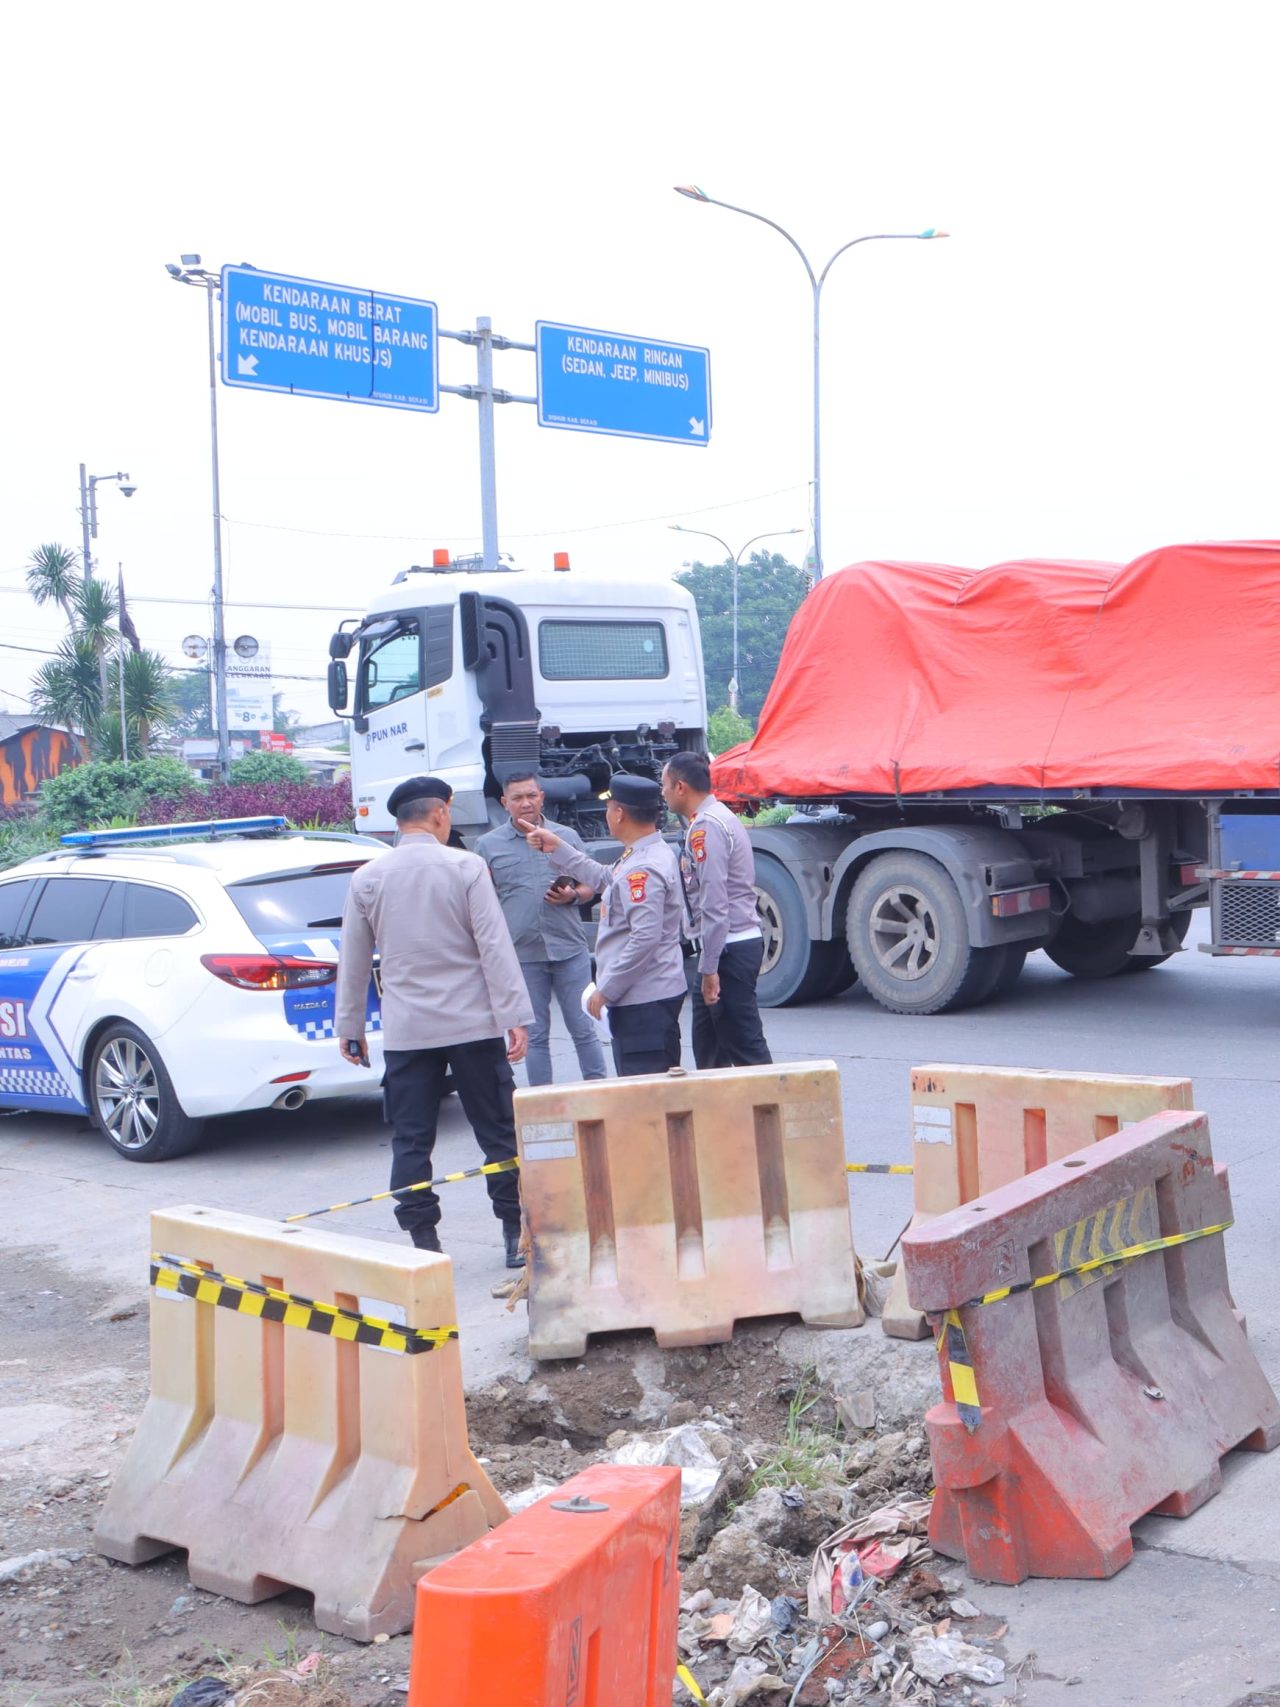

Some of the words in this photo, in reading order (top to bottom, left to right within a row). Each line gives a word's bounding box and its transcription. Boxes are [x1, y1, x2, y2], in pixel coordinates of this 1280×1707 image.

[263, 284, 350, 315] KENDARAAN
[358, 301, 402, 324] BERAT
[235, 301, 283, 328] (MOBIL
[328, 319, 368, 341] MOBIL
[374, 325, 428, 350] BARANG
[240, 328, 328, 358] KENDARAAN
[567, 336, 637, 361] KENDARAAN
[644, 350, 683, 369] RINGAN
[644, 368, 689, 392] MINIBUS)
